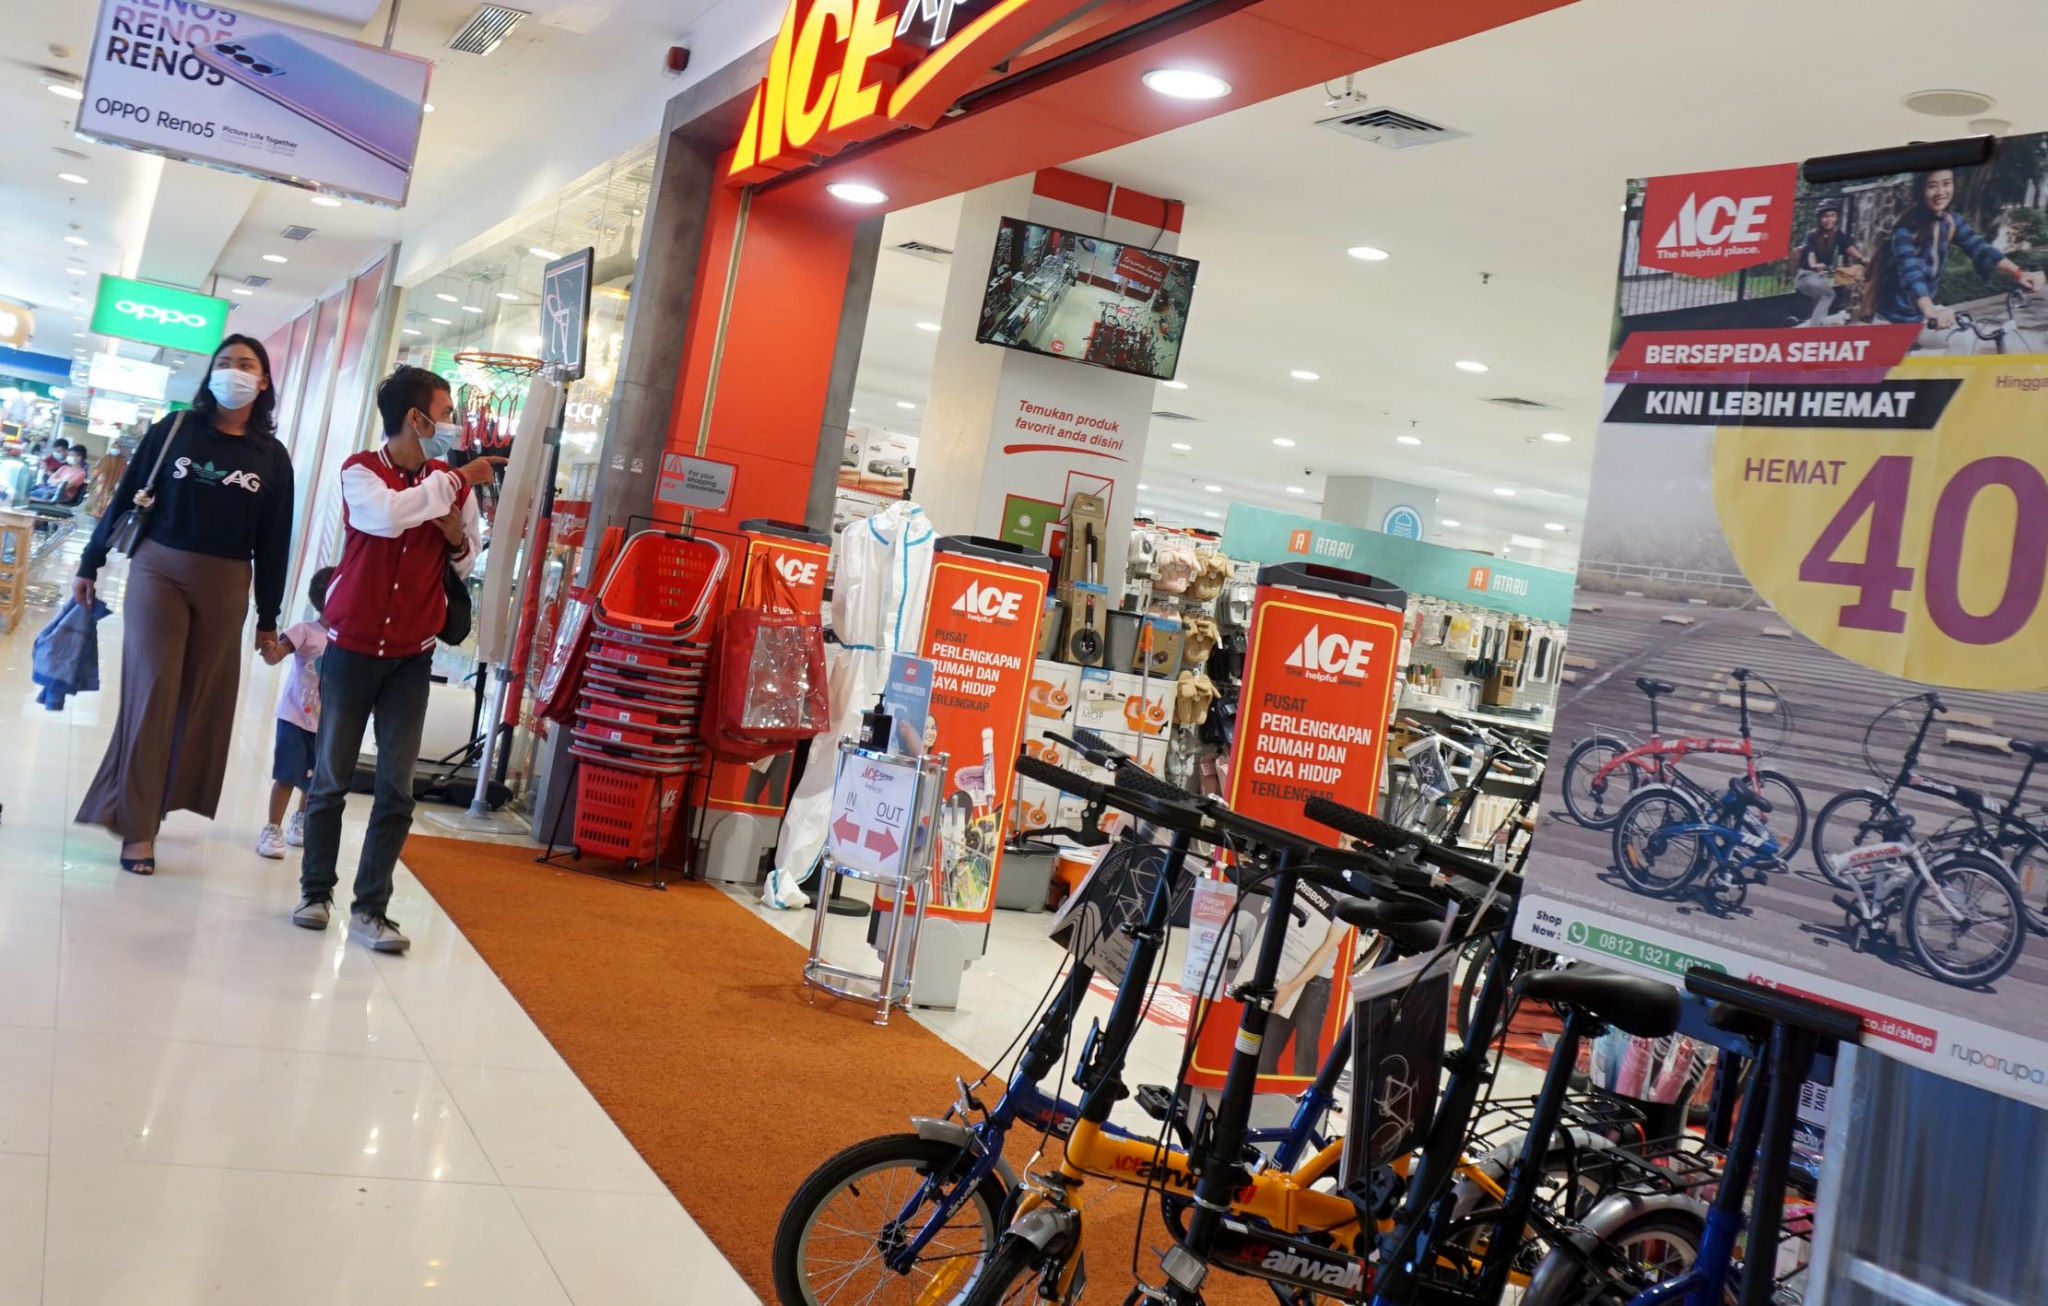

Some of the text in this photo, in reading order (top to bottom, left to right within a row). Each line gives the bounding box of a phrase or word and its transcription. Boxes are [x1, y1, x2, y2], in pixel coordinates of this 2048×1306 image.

[728, 0, 898, 175] ACE
[95, 97, 216, 138] OPPO Reno5
[1656, 191, 1773, 249] ACE
[1656, 245, 1761, 260] The helpful place.
[115, 299, 207, 328] oppo
[1644, 340, 1871, 365] BERSEPEDA SEHAT
[1996, 375, 2048, 392] Hingga
[1019, 400, 1120, 433] Temukan produk
[1644, 390, 1916, 419] KINI LEBIH HEMAT
[1015, 416, 1124, 451] favorit anda disini
[1743, 457, 1847, 487] HEMAT
[1315, 536, 1356, 560] ATARU
[1798, 454, 2048, 646] 40
[1492, 573, 1529, 596] ATARU
[950, 579, 1024, 621] ACE
[967, 612, 993, 624] helpful
[935, 628, 968, 644] PUSAT
[931, 642, 1021, 670] PERLENGKAPAN
[1284, 623, 1374, 679] ACE
[976, 666, 1001, 683] DAN
[1305, 670, 1338, 684] helpful
[931, 693, 990, 712] ERLENGKAP
[960, 680, 997, 698] HIDUP
[1263, 692, 1308, 713] PUSAT
[1260, 711, 1373, 746] PERLENGKAPAN
[1256, 734, 1347, 764] RUMAH DAN
[1253, 756, 1342, 785] GAYA HIDUP
[845, 791, 858, 808] IN
[876, 802, 905, 823] OUT
[1536, 910, 1562, 927] Shop
[1599, 933, 1633, 956] 0812
[1637, 945, 1671, 967] 1321
[1863, 1017, 1934, 1050] co.id/shop
